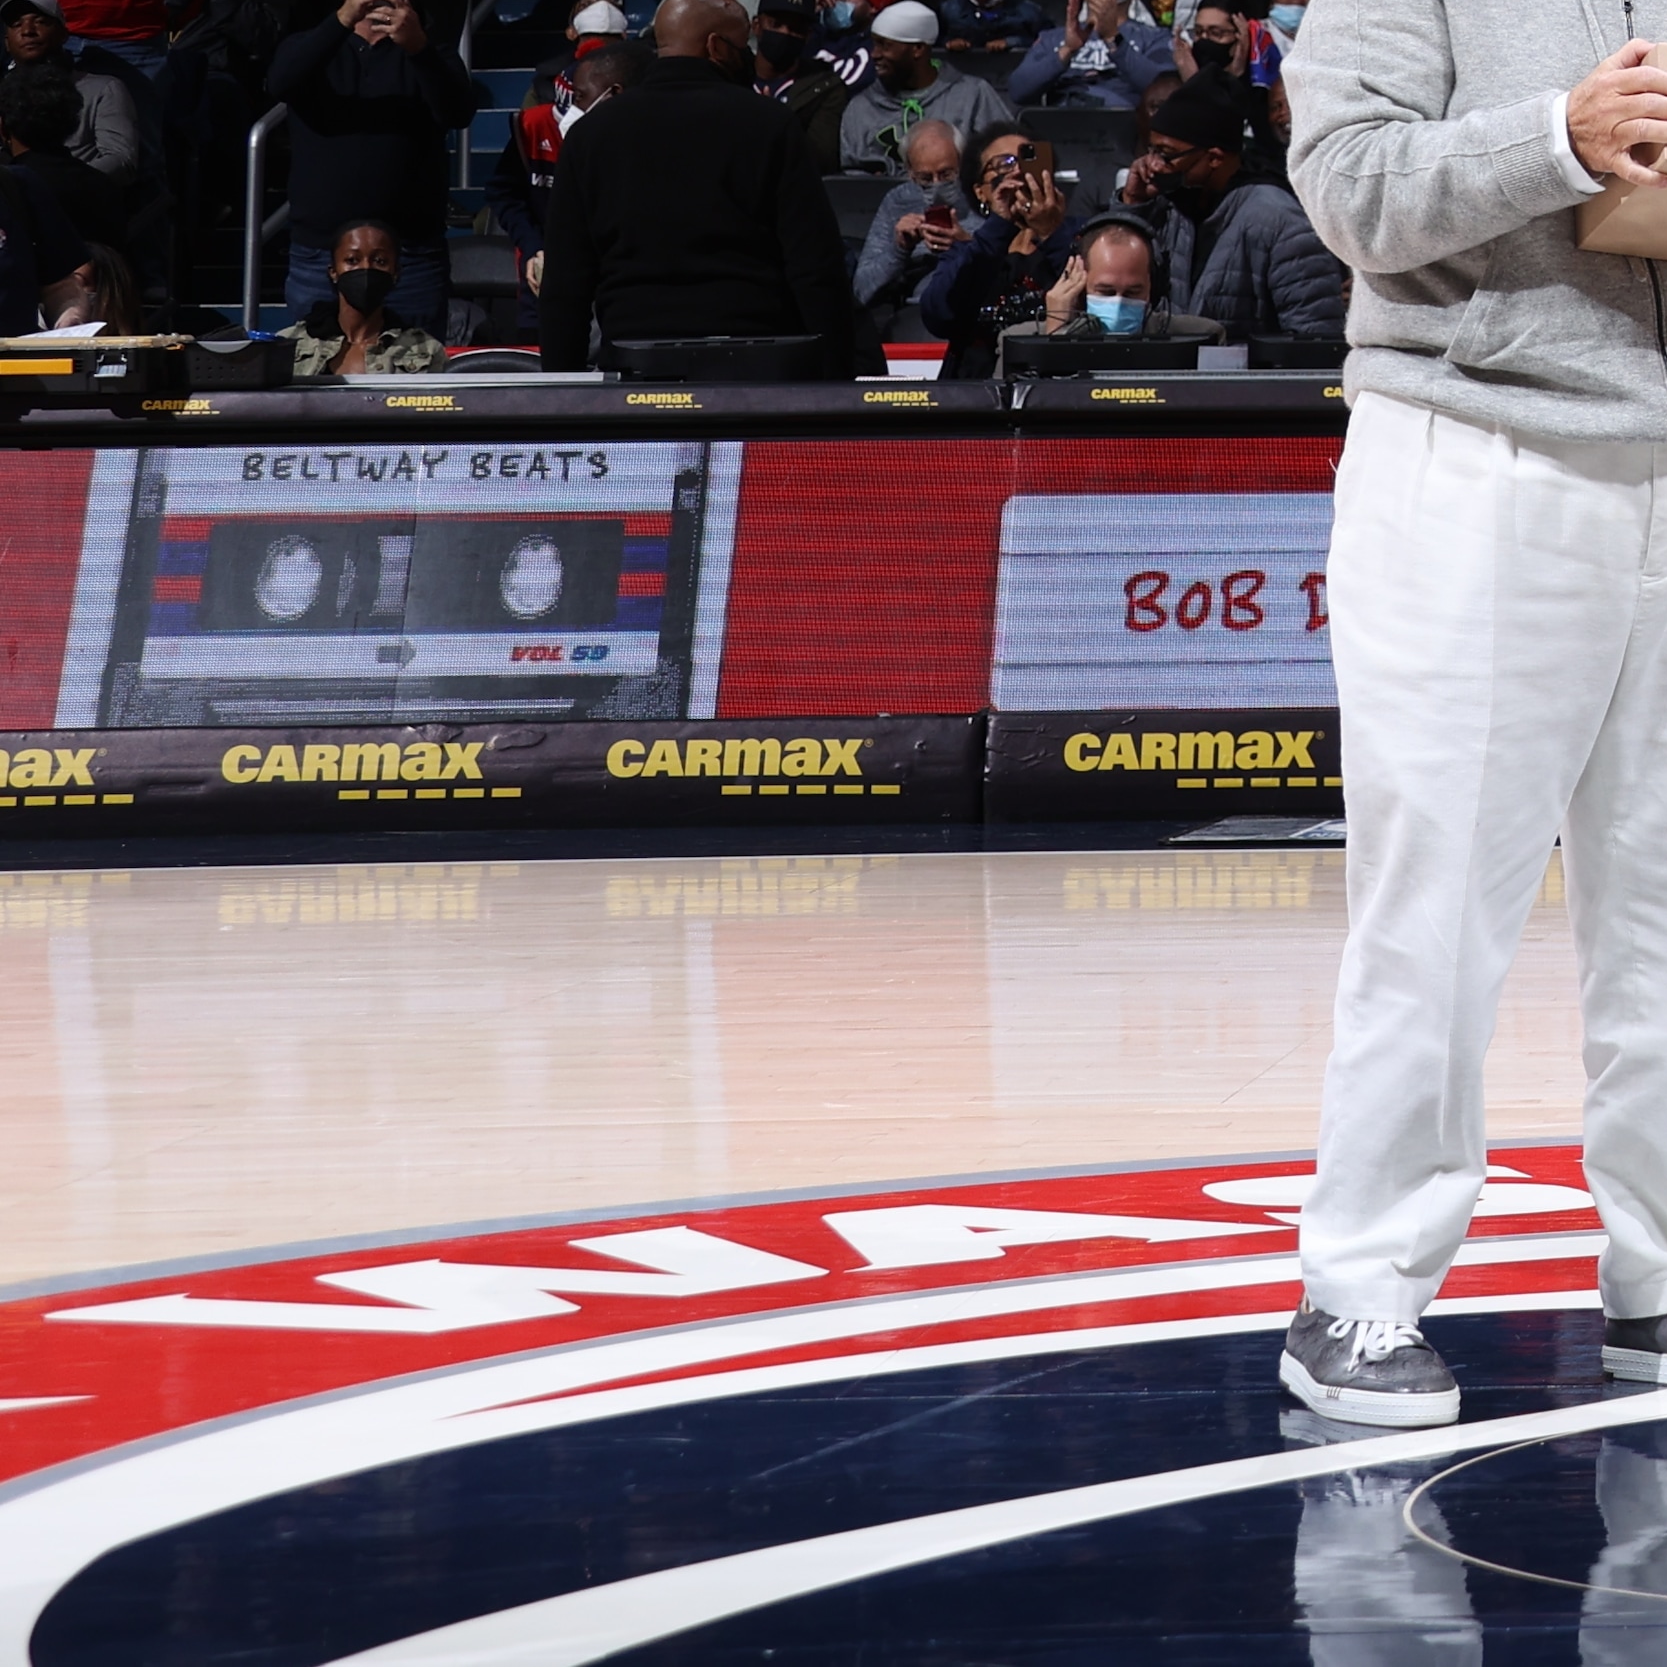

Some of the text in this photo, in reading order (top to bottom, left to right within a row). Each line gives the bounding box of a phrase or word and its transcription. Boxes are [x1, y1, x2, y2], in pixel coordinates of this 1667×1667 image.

[240, 448, 610, 484] BELTWAY BEATS
[1122, 568, 1268, 634] BOB
